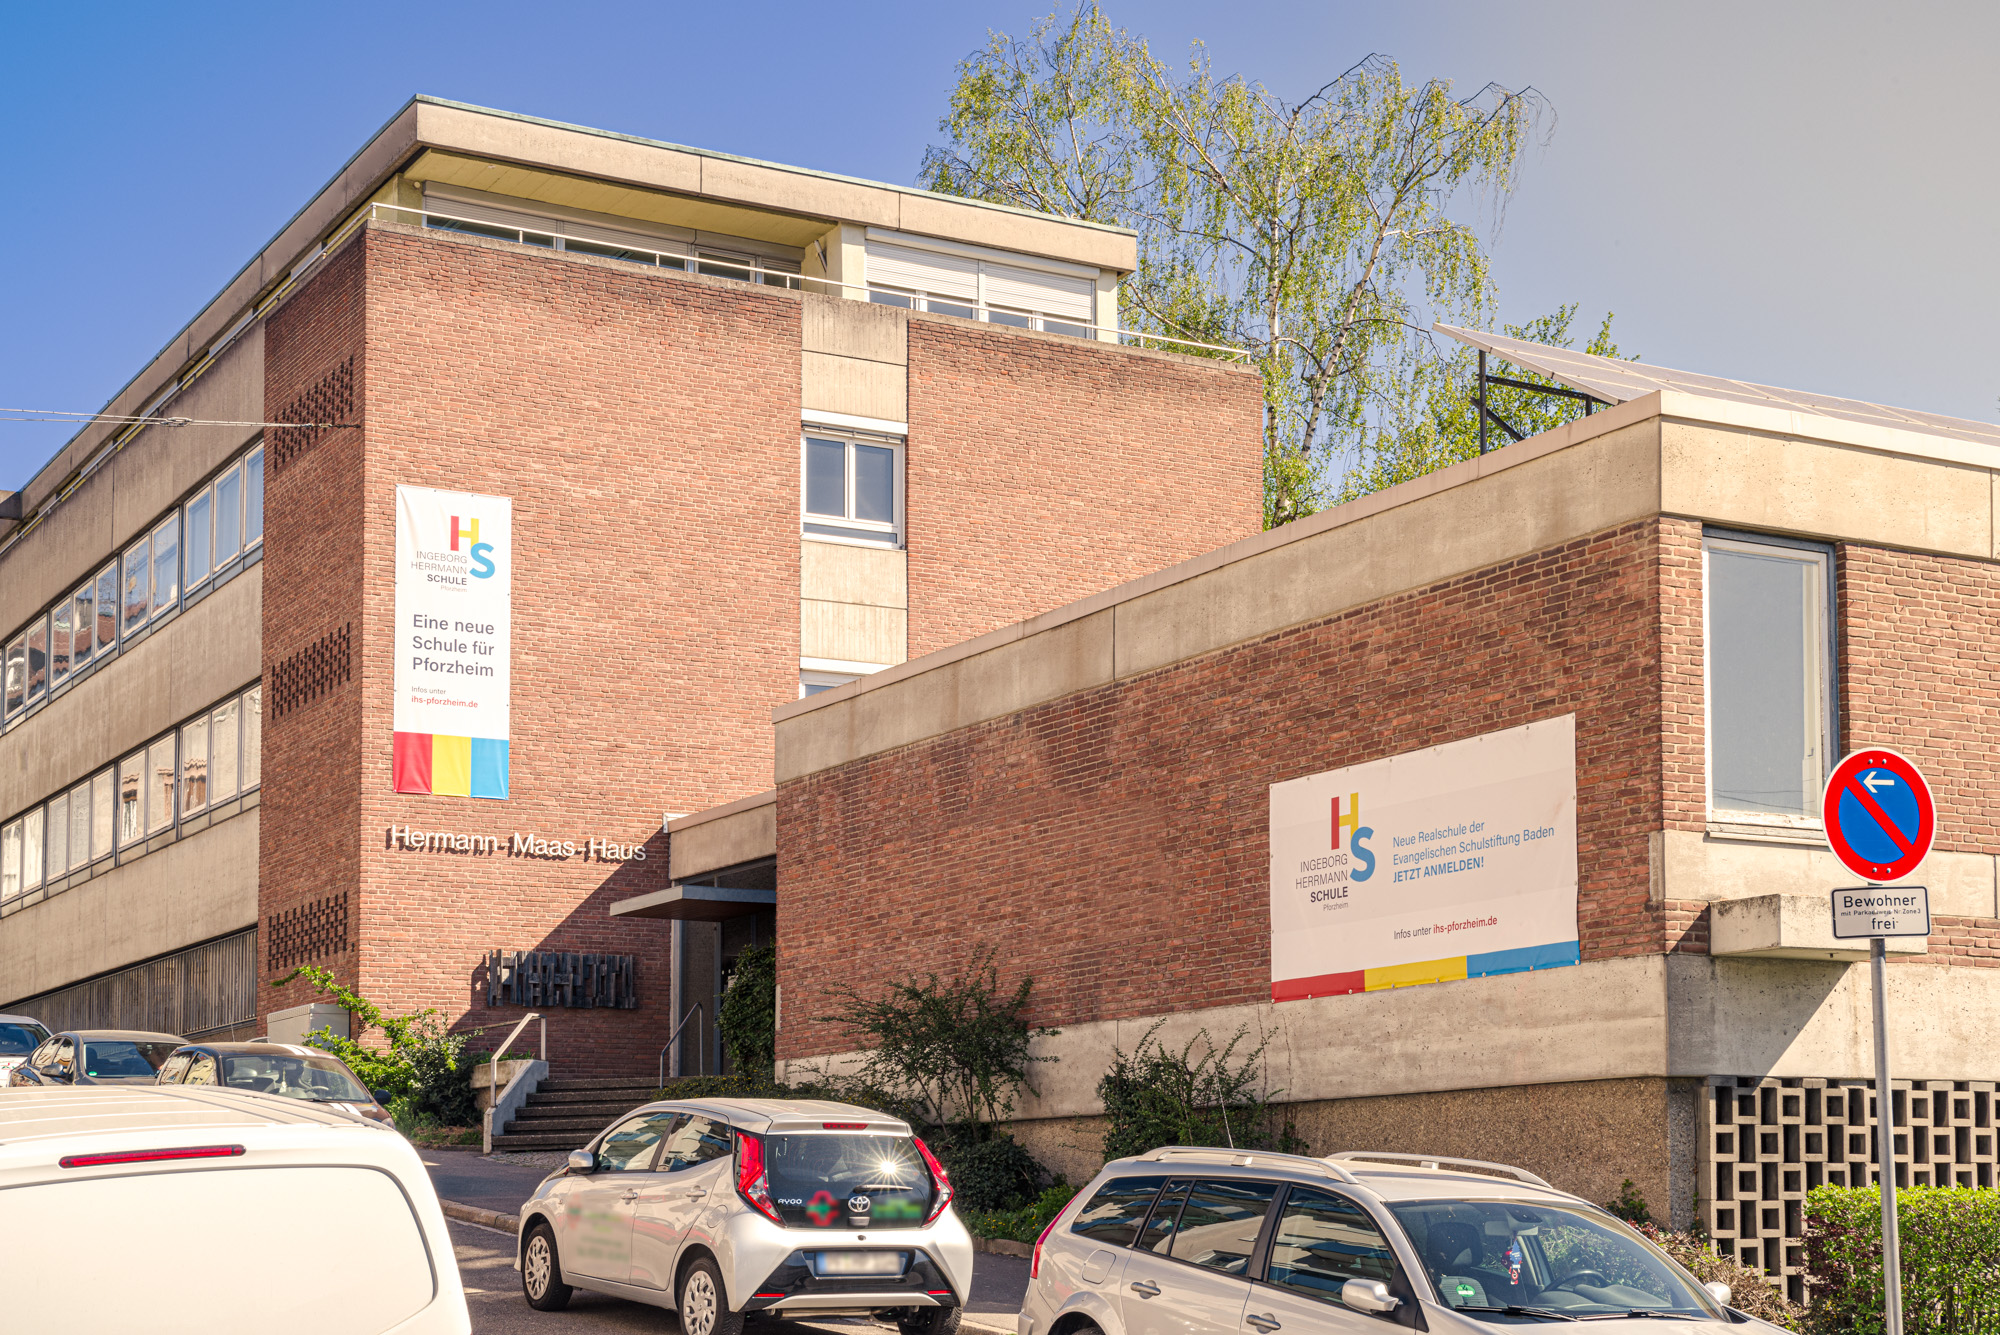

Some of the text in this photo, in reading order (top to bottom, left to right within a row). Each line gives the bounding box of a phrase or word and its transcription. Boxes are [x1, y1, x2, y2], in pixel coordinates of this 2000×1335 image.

[416, 550, 467, 564] INGEBORG
[411, 561, 467, 575] HERRMANN
[427, 574, 467, 586] SCHULE
[440, 585, 467, 593] Pforzheim
[413, 614, 495, 635] Eine neue
[412, 635, 495, 656] Schule für
[412, 657, 494, 677] Pforzheim
[411, 686, 428, 694] Infos
[411, 695, 478, 708] ihs-pforzheim.de
[1393, 821, 1485, 848] Neue Realschule der
[1393, 826, 1555, 865] Evangelischen Schulstiftung Baden
[1300, 854, 1348, 873] INGEBORG
[1393, 856, 1484, 883] JETZT ANMELDEN!
[1295, 870, 1348, 889] HERRMANN
[1310, 886, 1349, 902] SCHULE
[1843, 894, 1917, 908] Bewohner
[1323, 902, 1348, 911] Pforzheim
[1393, 915, 1498, 940] Infos unter ihs-pforzheim.de
[1871, 917, 1896, 930] frei
